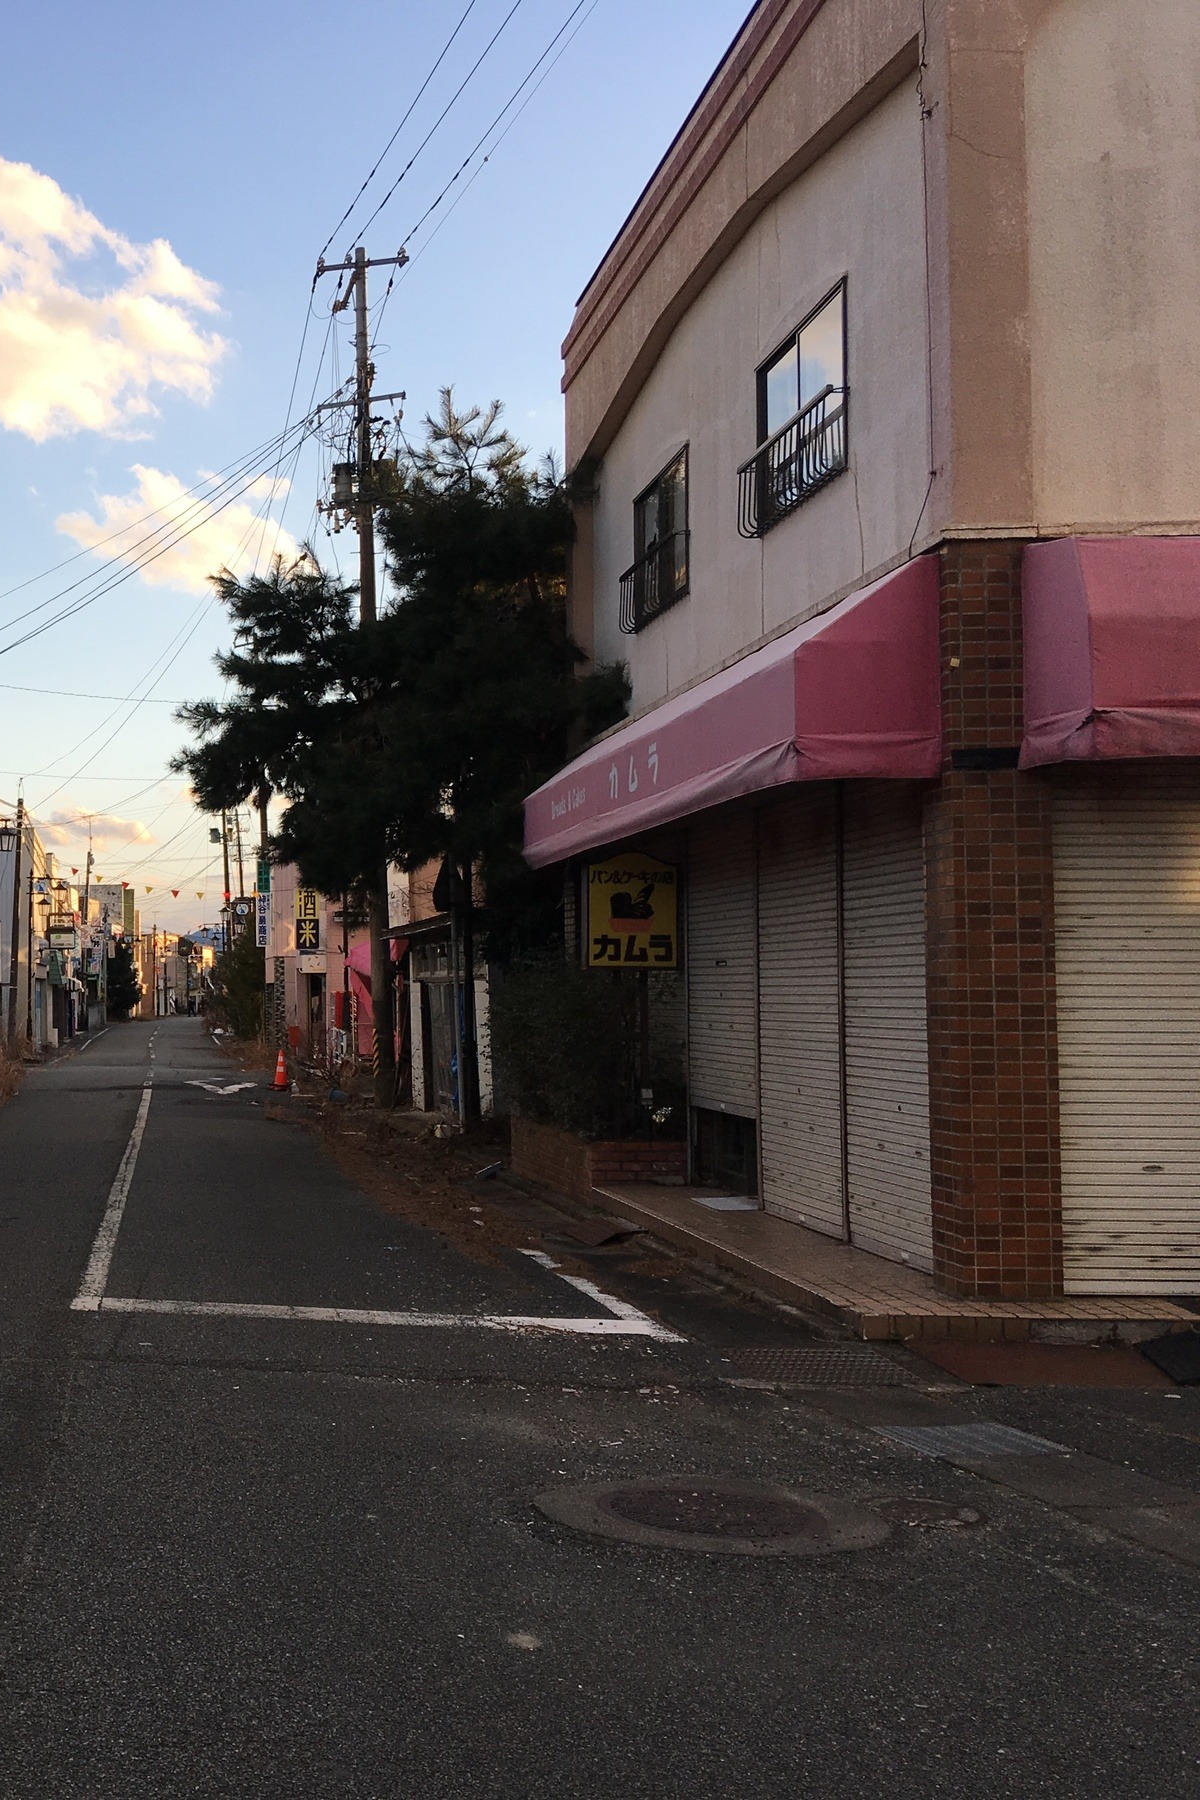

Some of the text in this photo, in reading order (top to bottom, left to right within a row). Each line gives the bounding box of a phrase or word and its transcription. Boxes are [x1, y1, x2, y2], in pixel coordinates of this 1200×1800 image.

[608, 741, 659, 800] カムラ
[593, 934, 673, 963] カムラ
